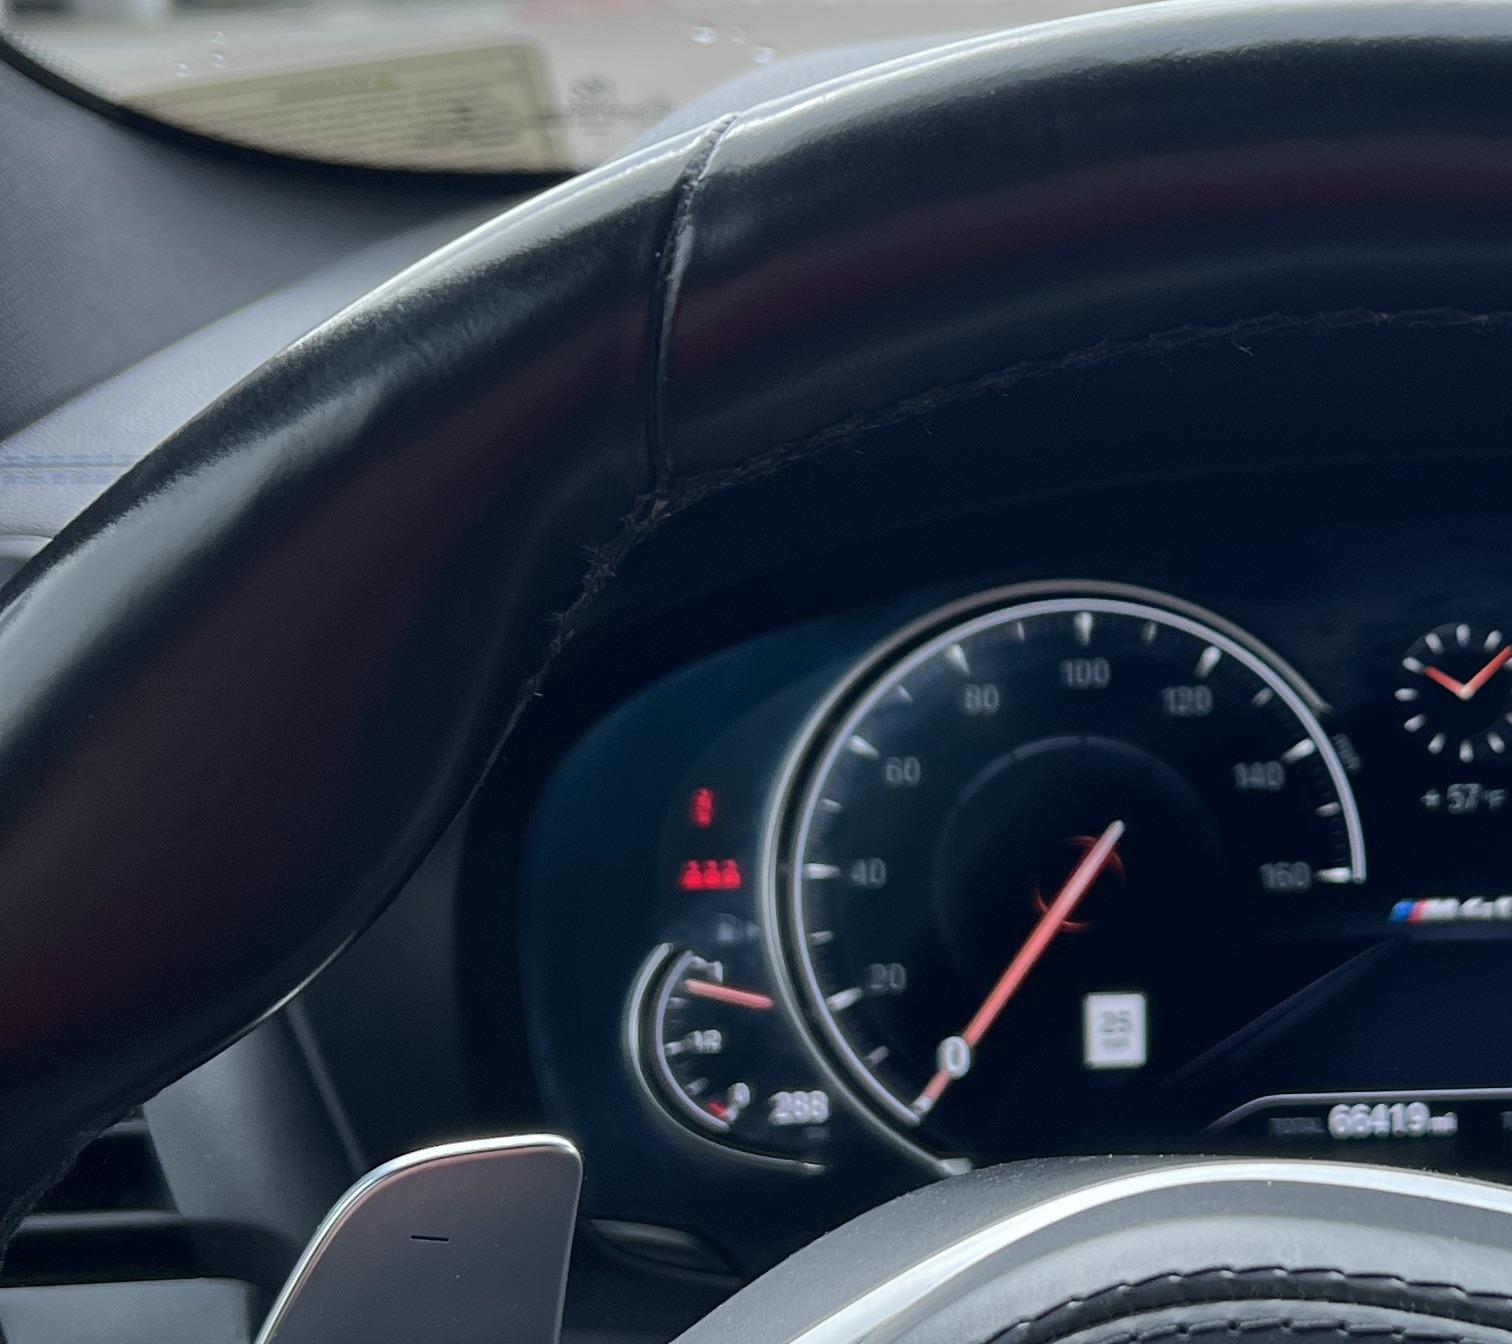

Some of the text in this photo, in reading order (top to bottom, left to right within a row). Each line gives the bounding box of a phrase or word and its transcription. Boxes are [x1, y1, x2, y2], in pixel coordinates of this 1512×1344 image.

[1061, 656, 1110, 688] 100
[964, 684, 1000, 714] 80
[1163, 683, 1213, 716] 120
[884, 755, 921, 786] 60
[1233, 762, 1286, 791] 140
[849, 857, 887, 887] 40
[1261, 861, 1310, 892] 160
[868, 961, 908, 993] 20
[938, 1035, 972, 1079] 0
